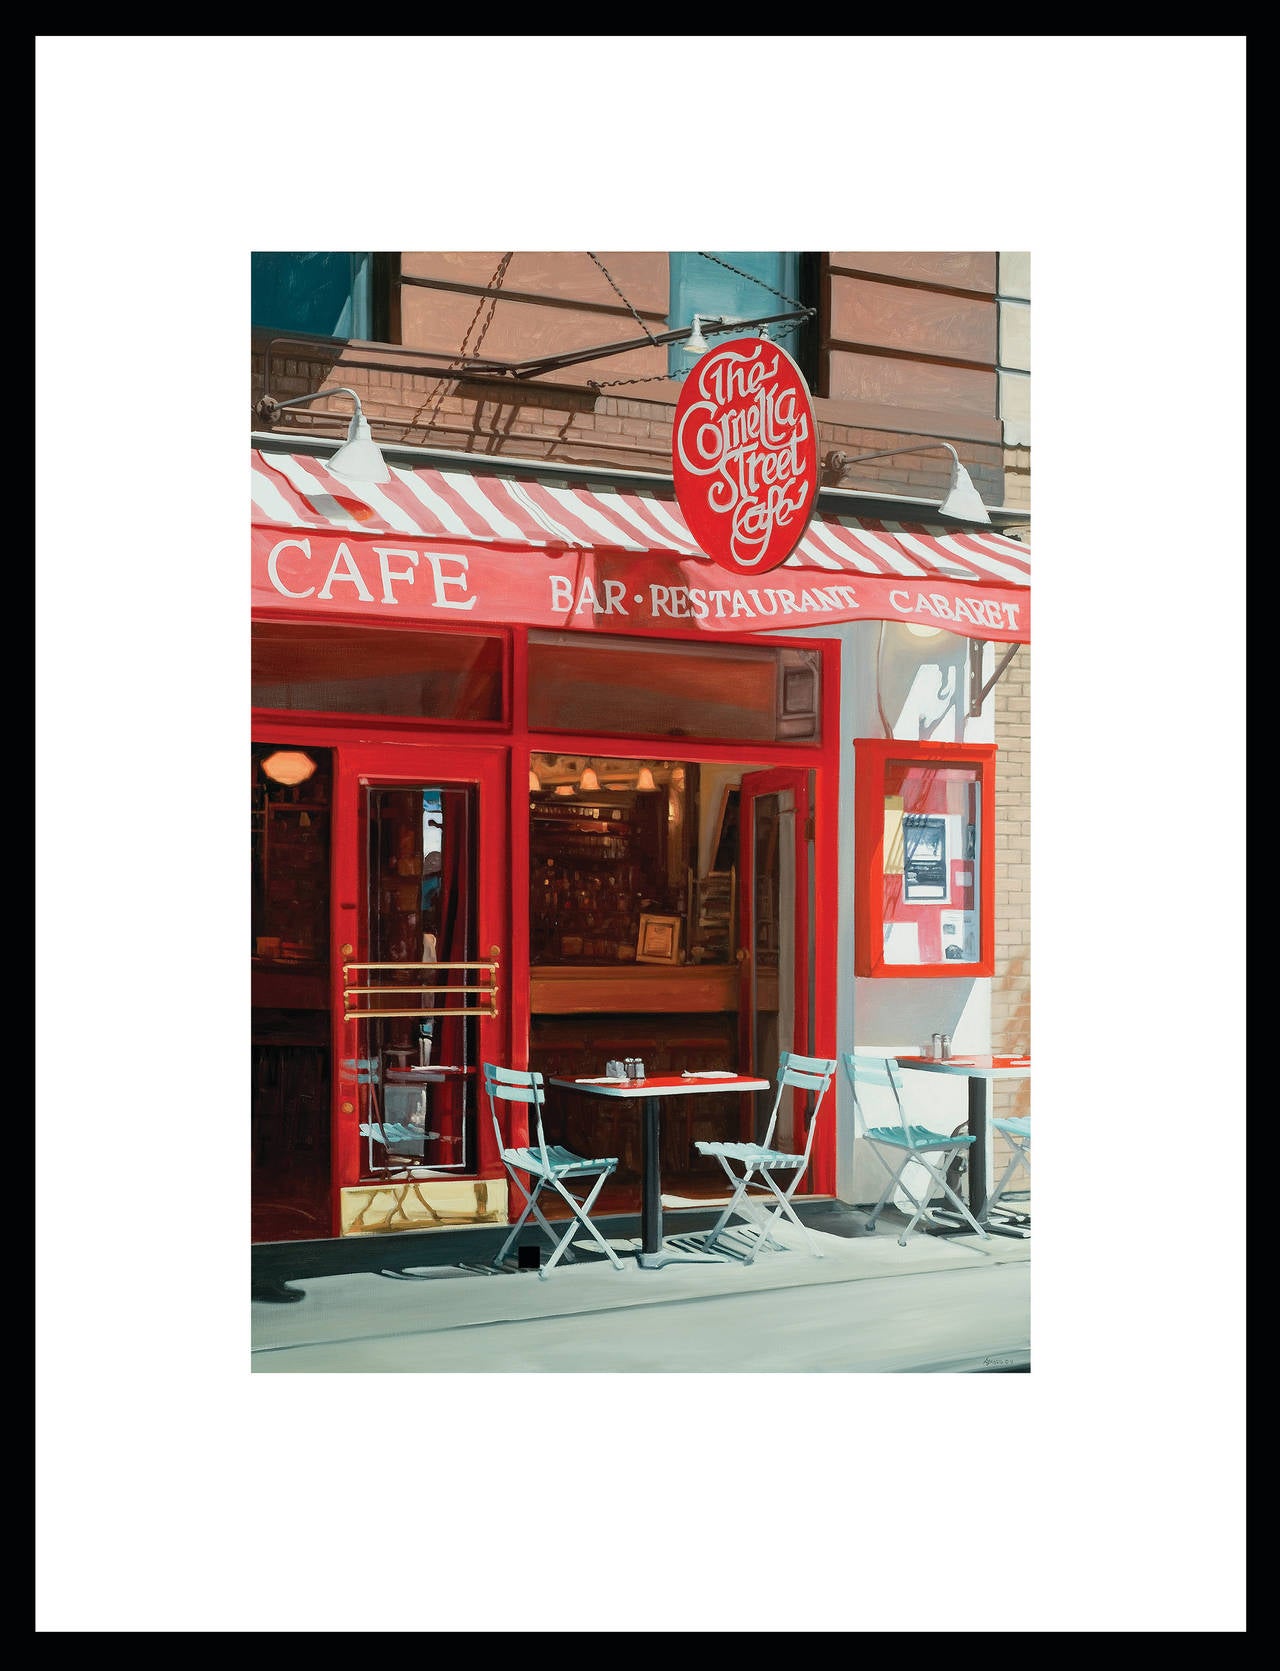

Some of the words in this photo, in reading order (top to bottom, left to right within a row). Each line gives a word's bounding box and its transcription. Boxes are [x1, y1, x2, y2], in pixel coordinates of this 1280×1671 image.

[698, 344, 779, 406] The
[708, 411, 809, 513] Street
[267, 538, 477, 611] CAFE
[549, 575, 629, 616] BAR
[648, 584, 860, 619] RESTAURANT
[888, 589, 1020, 631] CABARET
